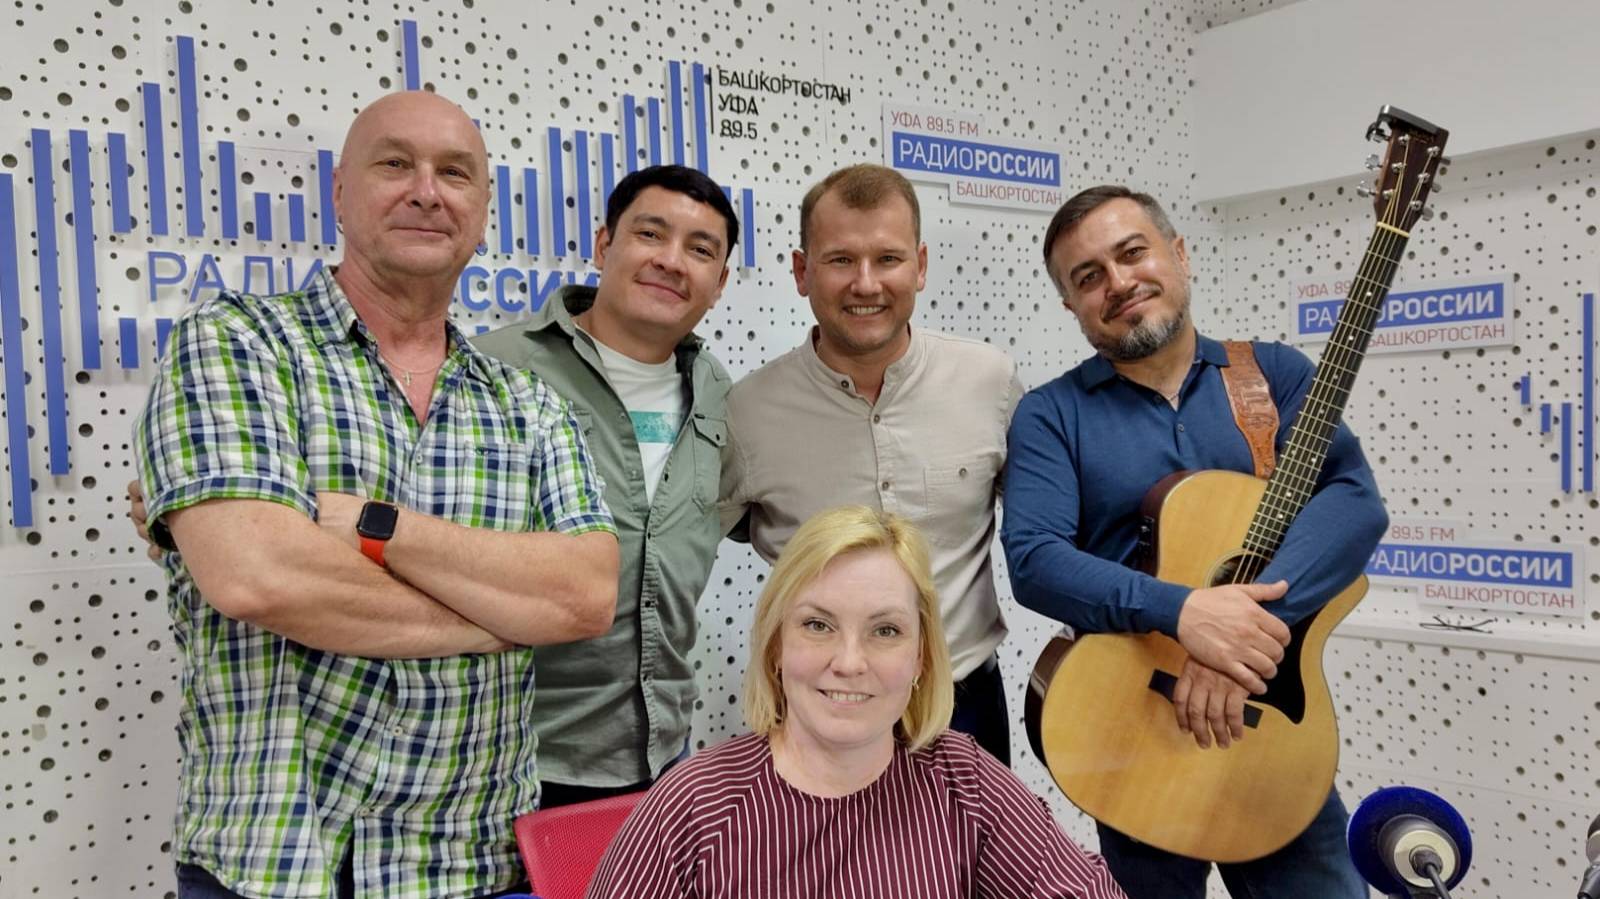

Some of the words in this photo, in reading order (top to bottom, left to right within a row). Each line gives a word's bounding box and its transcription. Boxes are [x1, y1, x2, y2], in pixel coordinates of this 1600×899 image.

[718, 69, 851, 104] БАШКОРТОСТАН
[718, 94, 759, 116] УФА
[720, 119, 758, 140] 89.5
[890, 110, 922, 129] УФА
[926, 115, 955, 134] 89.5
[959, 120, 979, 137] FM
[899, 138, 1055, 182] РАДИОРОССИИ
[956, 180, 1063, 205] БАШКОРТОСТАН
[1297, 282, 1329, 299] УФА
[1391, 525, 1424, 540] 89.5
[1430, 527, 1455, 542] FM
[1425, 583, 1575, 609] БАШКОРТОСТАН
